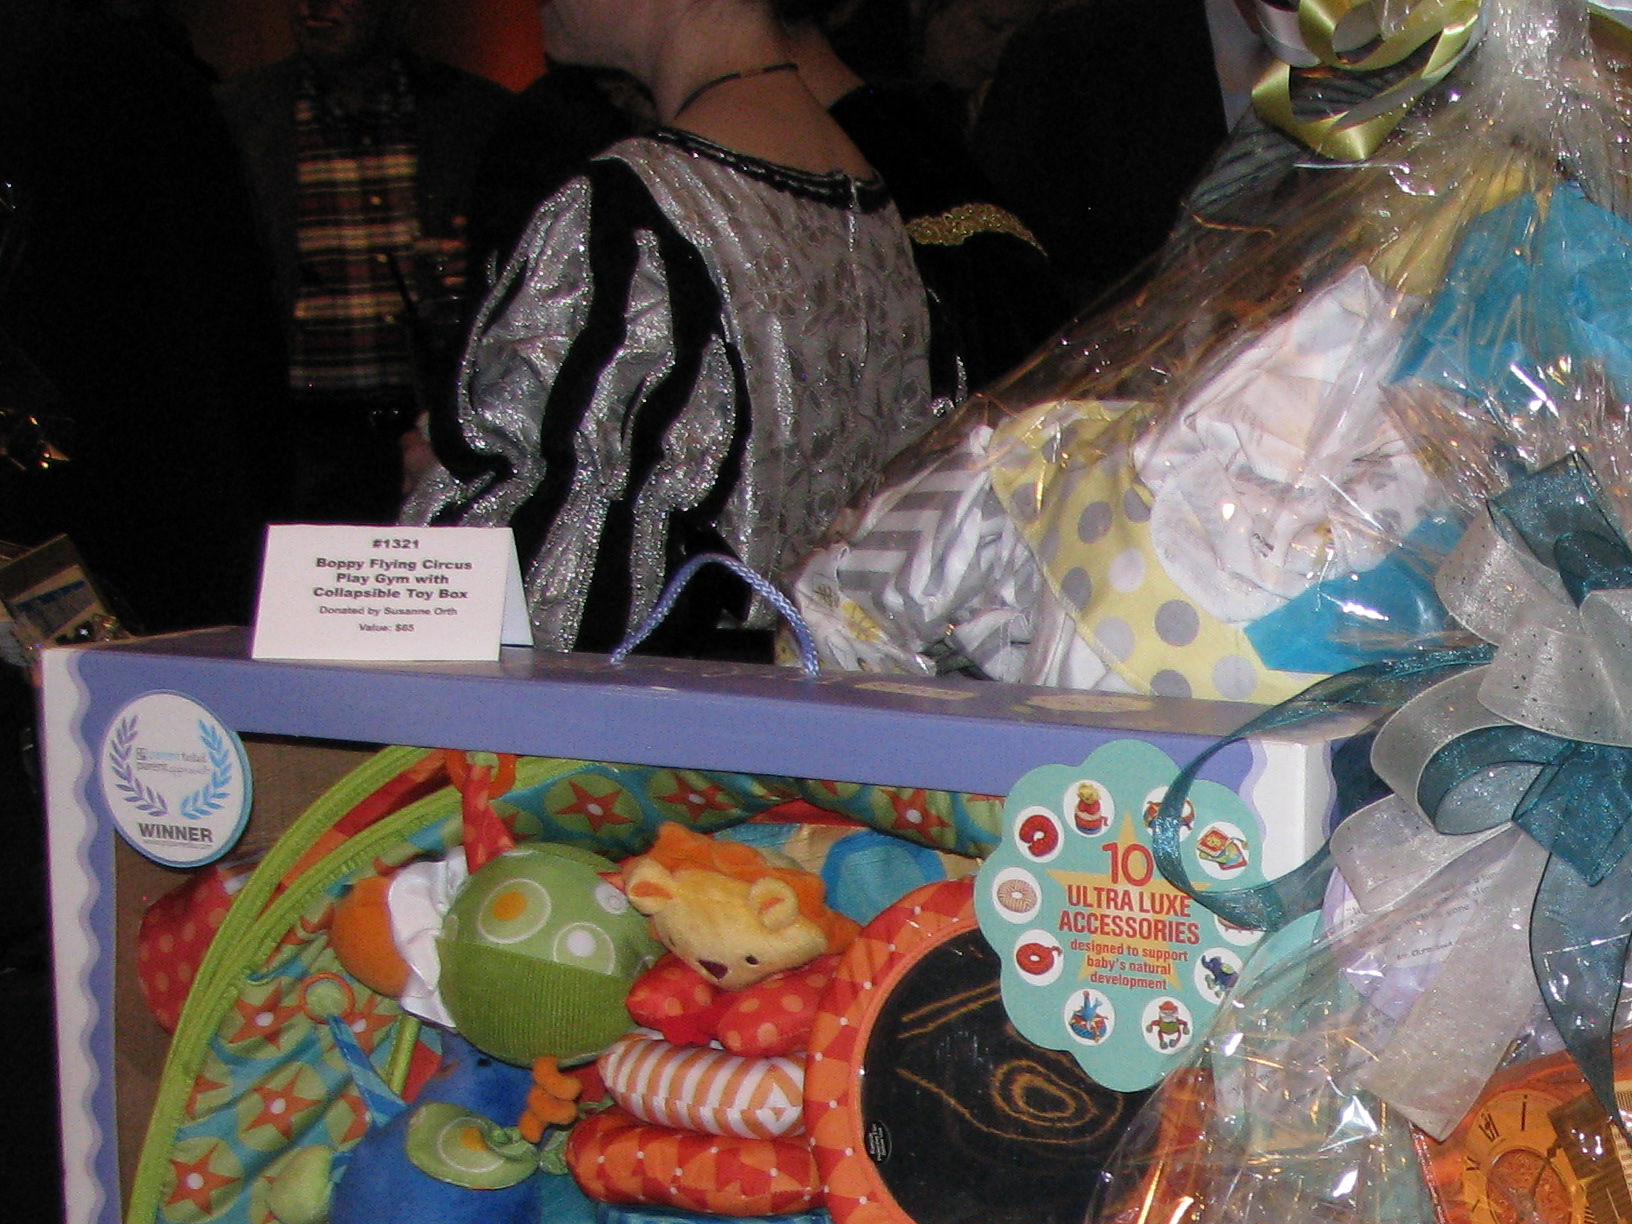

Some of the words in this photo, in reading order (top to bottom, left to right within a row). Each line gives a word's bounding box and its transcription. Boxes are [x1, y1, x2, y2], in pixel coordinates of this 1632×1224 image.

[372, 539, 419, 549] #1321
[316, 558, 364, 570] Boppy
[370, 558, 416, 571] Flying
[423, 560, 472, 570] Circus
[336, 573, 369, 585] Play
[375, 574, 410, 585] Gym
[416, 575, 449, 584] with
[313, 588, 401, 599] Collapsible
[407, 589, 432, 600] Toy
[439, 589, 468, 599] Box
[319, 606, 364, 615] Donated
[368, 607, 380, 616] by
[384, 607, 431, 615] Susanne
[359, 624, 391, 632] Value:
[138, 823, 213, 842] WINNER
[1101, 842, 1154, 887] 10
[1068, 886, 1138, 914] ULTRA
[1139, 892, 1192, 918] LUXE
[1059, 911, 1200, 945] ACCESSORIES
[1071, 939, 1124, 957] designed
[1127, 945, 1139, 956] to
[1142, 947, 1189, 963] support
[1087, 956, 1126, 973] baby's
[1129, 961, 1171, 975] natural
[1090, 973, 1167, 991] development
